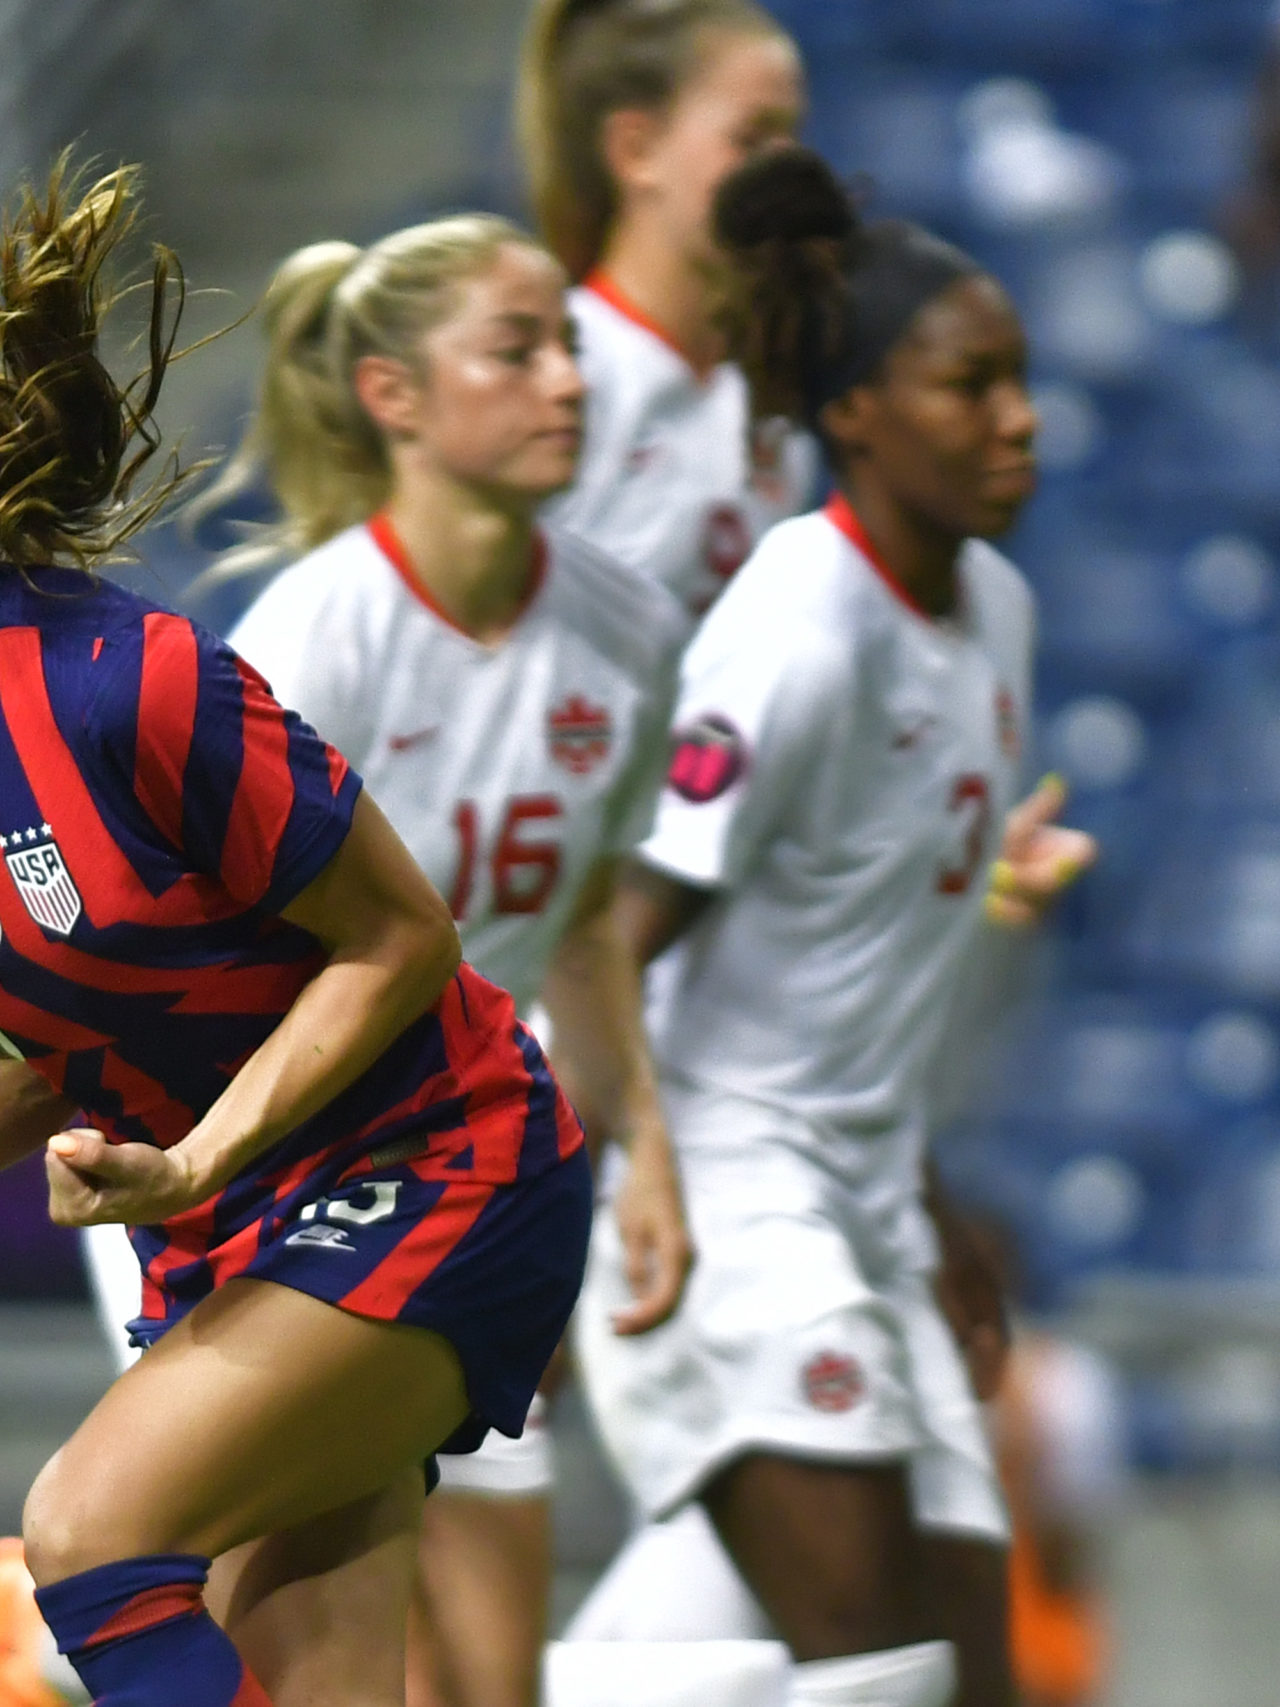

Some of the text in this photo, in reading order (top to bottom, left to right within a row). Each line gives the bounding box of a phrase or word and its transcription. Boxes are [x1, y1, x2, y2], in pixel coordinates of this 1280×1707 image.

[11, 848, 60, 886] USA
[450, 794, 562, 920] 16
[938, 773, 989, 894] 3
